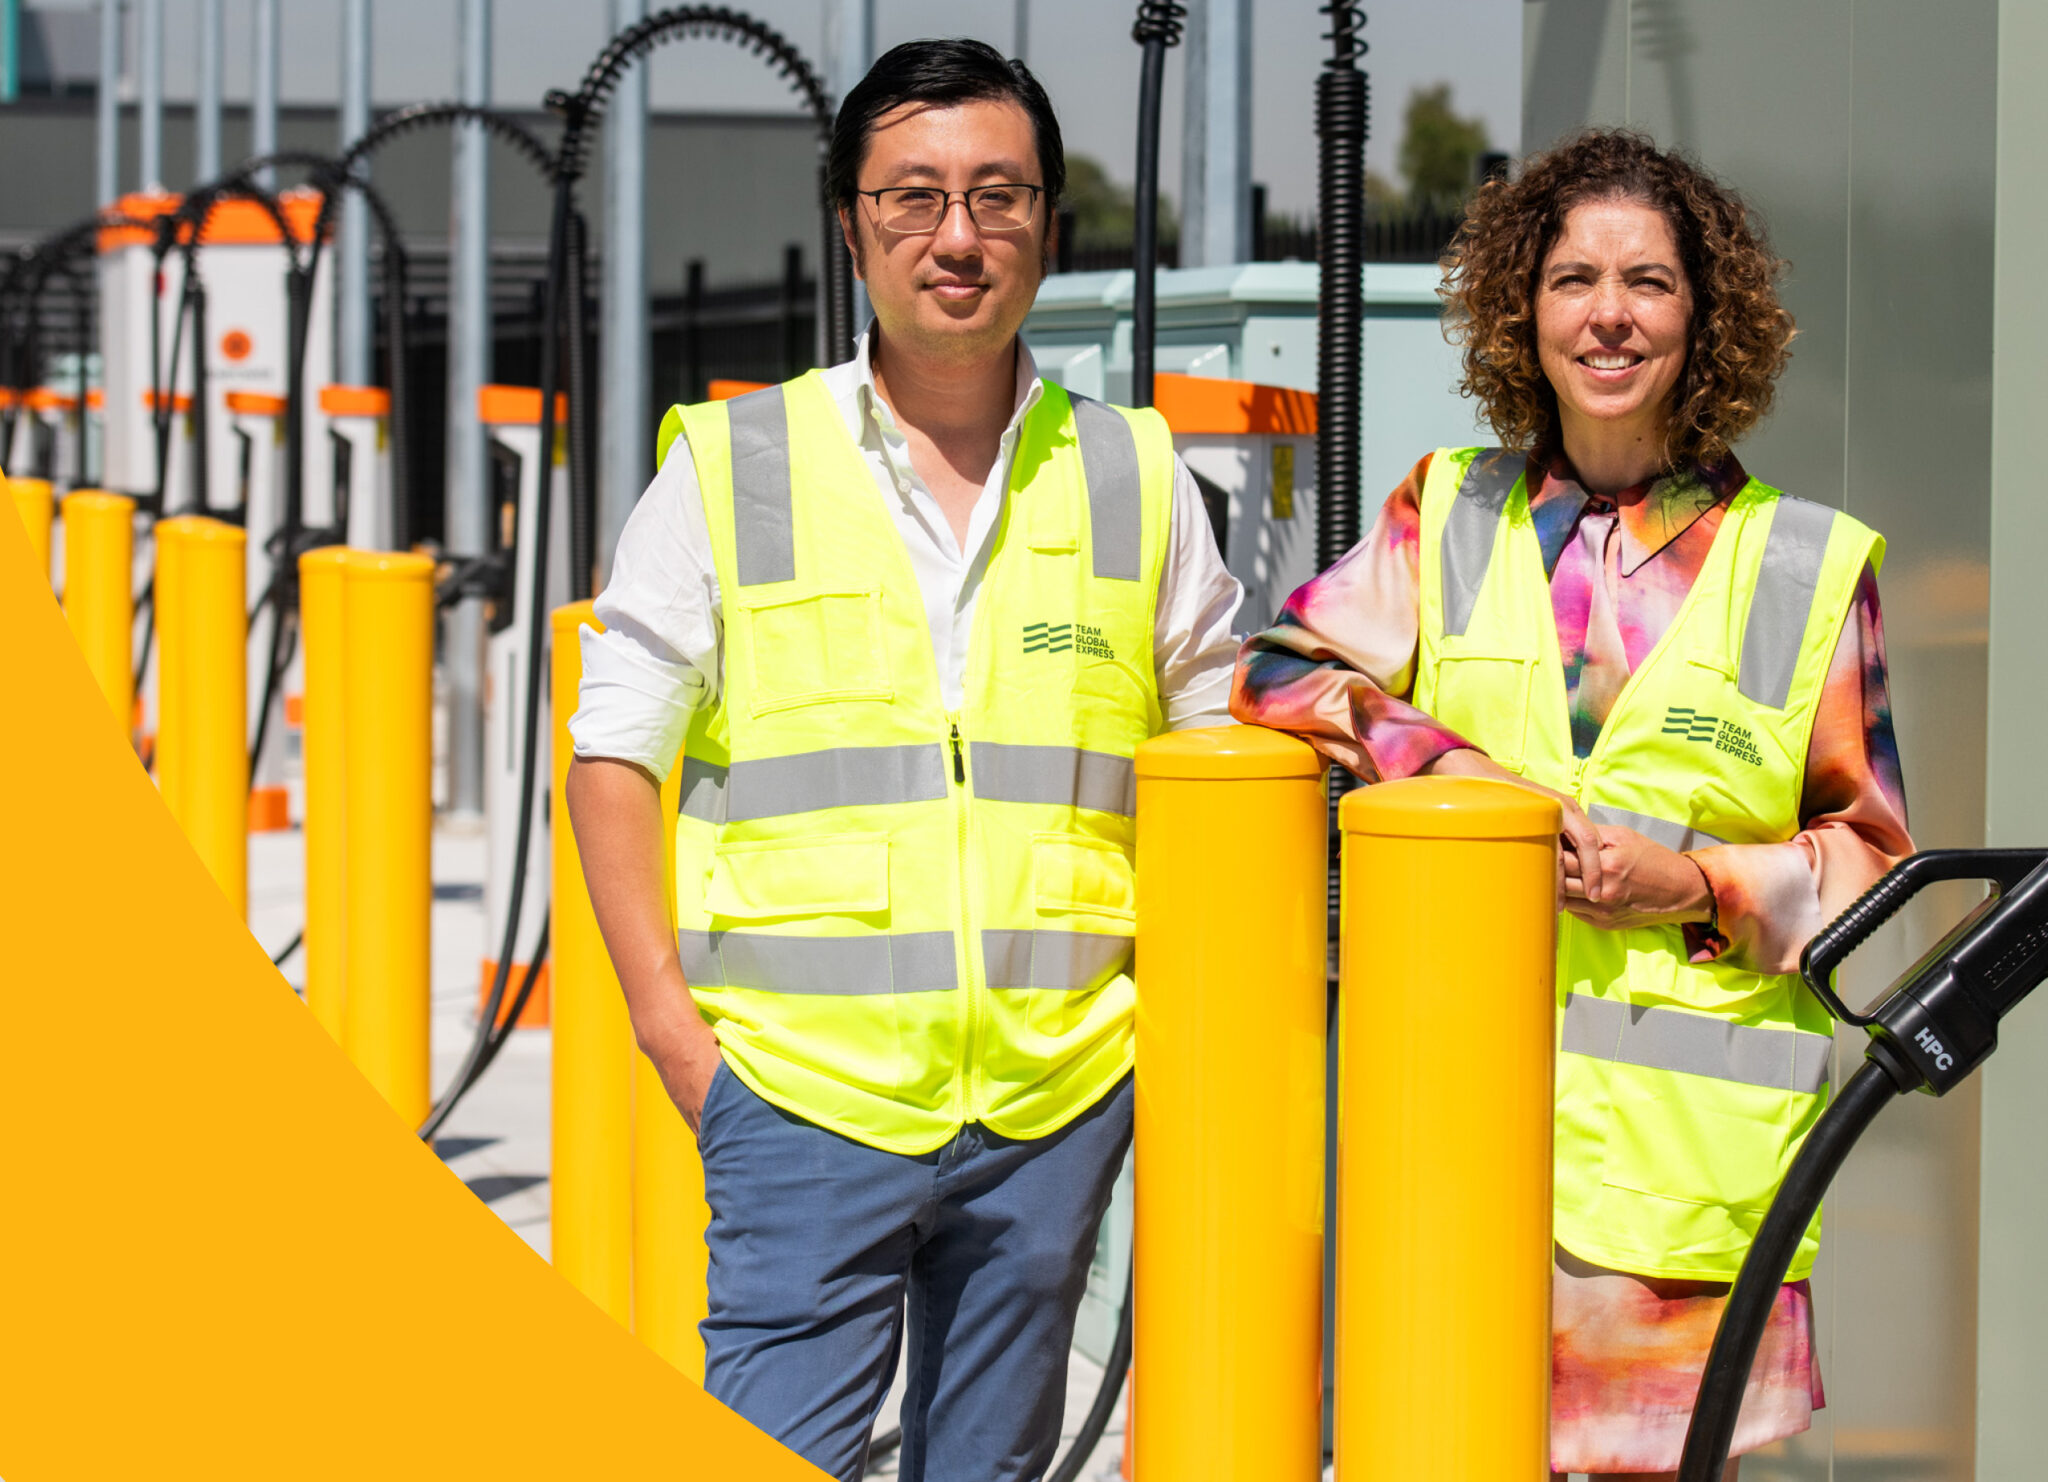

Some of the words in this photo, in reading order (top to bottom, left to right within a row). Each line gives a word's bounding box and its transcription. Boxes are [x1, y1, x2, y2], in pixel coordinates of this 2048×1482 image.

[1075, 624, 1101, 636] TEAM
[1075, 635, 1110, 649] GLOBAL
[1076, 644, 1115, 660] EXPRESS
[1722, 720, 1752, 739] TEAM
[1718, 730, 1759, 754] GLOBAL
[1715, 739, 1763, 766] EXPRESS
[1914, 1026, 1954, 1071] HPC
